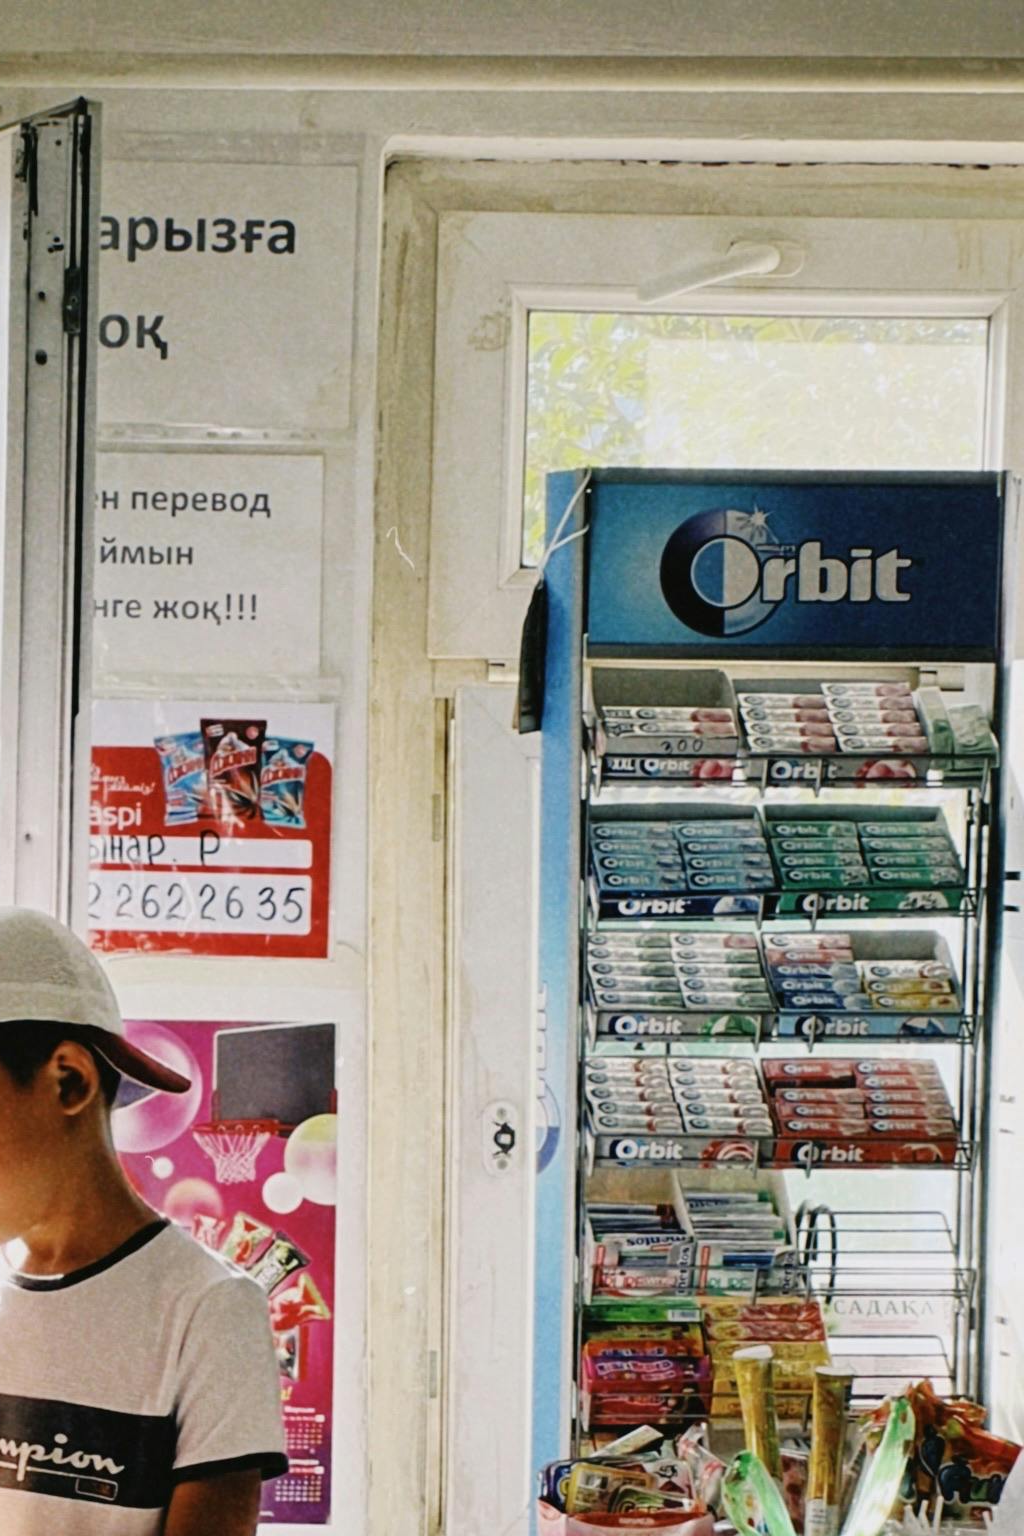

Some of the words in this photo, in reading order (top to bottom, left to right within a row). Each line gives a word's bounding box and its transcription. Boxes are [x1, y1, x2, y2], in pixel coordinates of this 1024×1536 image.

[131, 490, 271, 518] перевод
[100, 537, 194, 565] ймын
[660, 509, 912, 637] Orbit
[153, 593, 257, 626] жоқ!!!
[617, 899, 686, 915] Orbit
[802, 893, 870, 911] Orbit
[614, 1015, 683, 1035] Orbit
[801, 1017, 869, 1036] Orbit
[615, 1139, 683, 1160] Orbit
[796, 1143, 865, 1163] Orbit
